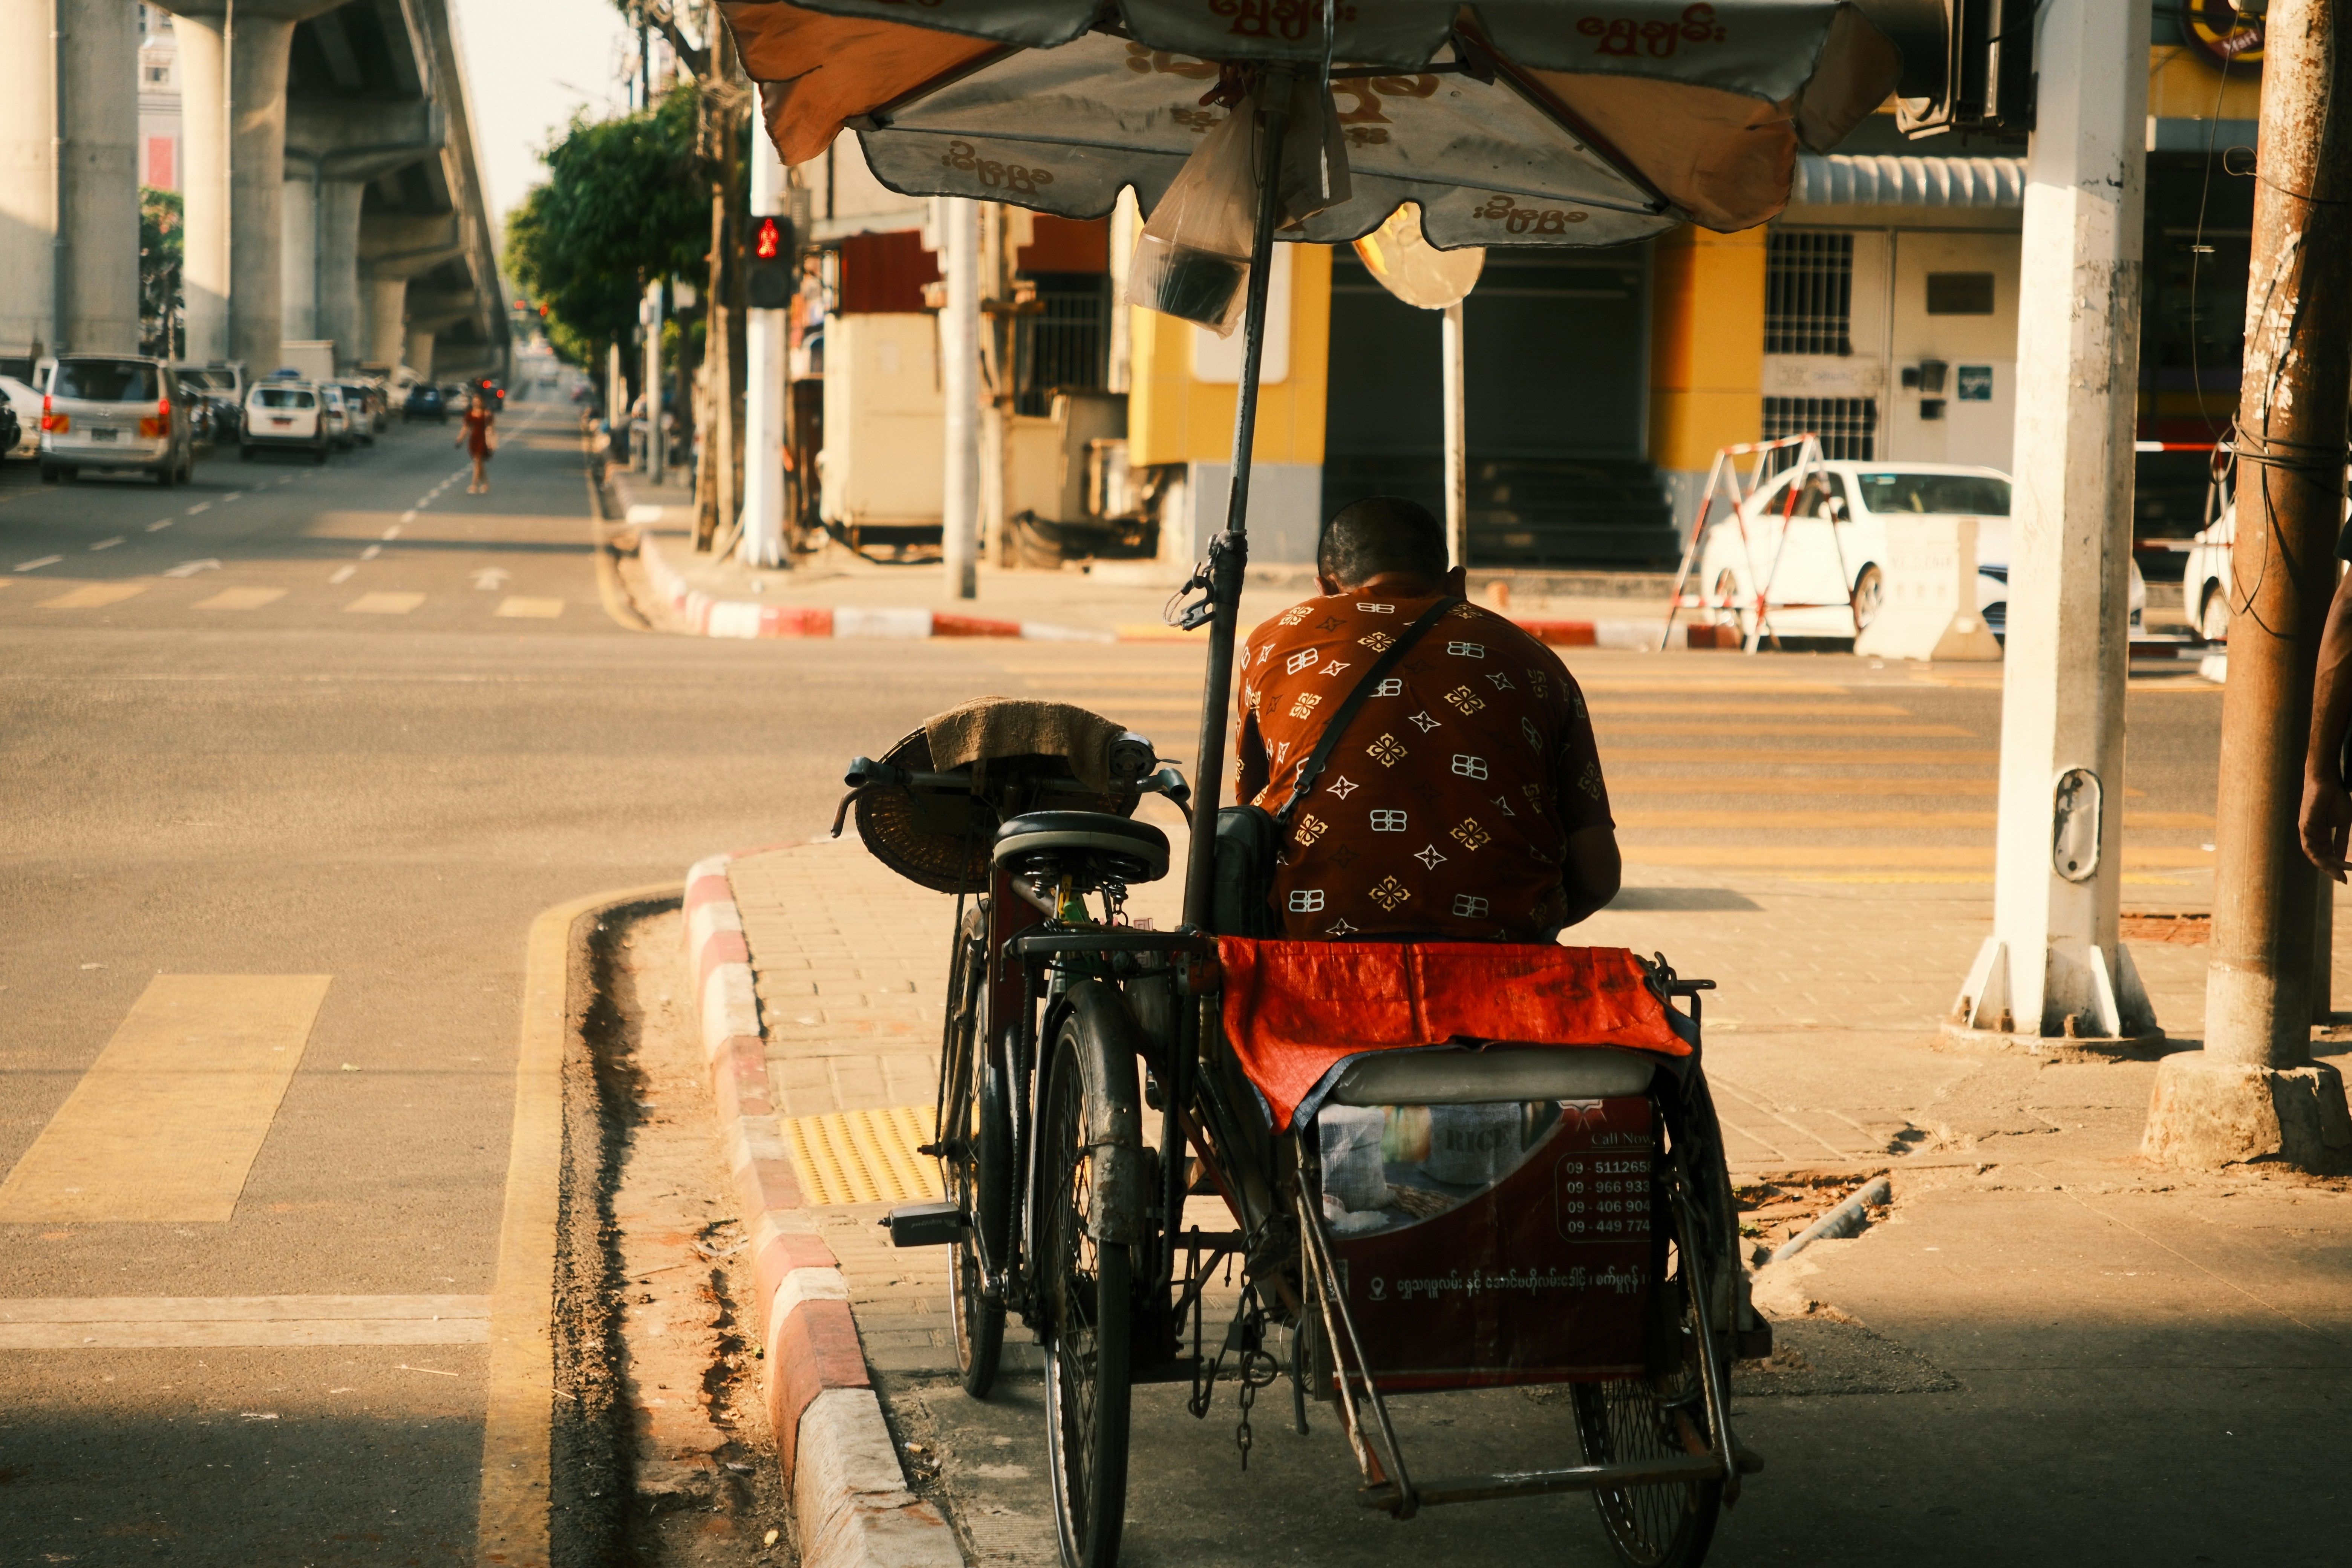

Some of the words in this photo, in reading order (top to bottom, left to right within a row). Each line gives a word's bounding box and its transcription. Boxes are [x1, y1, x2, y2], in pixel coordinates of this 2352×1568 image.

[1447, 1128, 1510, 1152] RICE
[1591, 1133, 1618, 1145] Call
[1566, 1162, 1583, 1174] 09
[1567, 1182, 1584, 1194] 09
[1596, 1181, 1622, 1193] 966
[1625, 1181, 1650, 1193] 933
[1568, 1201, 1585, 1214] 09
[1596, 1200, 1622, 1213] 406
[1626, 1200, 1651, 1213] 904
[1568, 1221, 1585, 1233] 09
[1597, 1220, 1622, 1233] 449
[1626, 1219, 1651, 1232] 774
